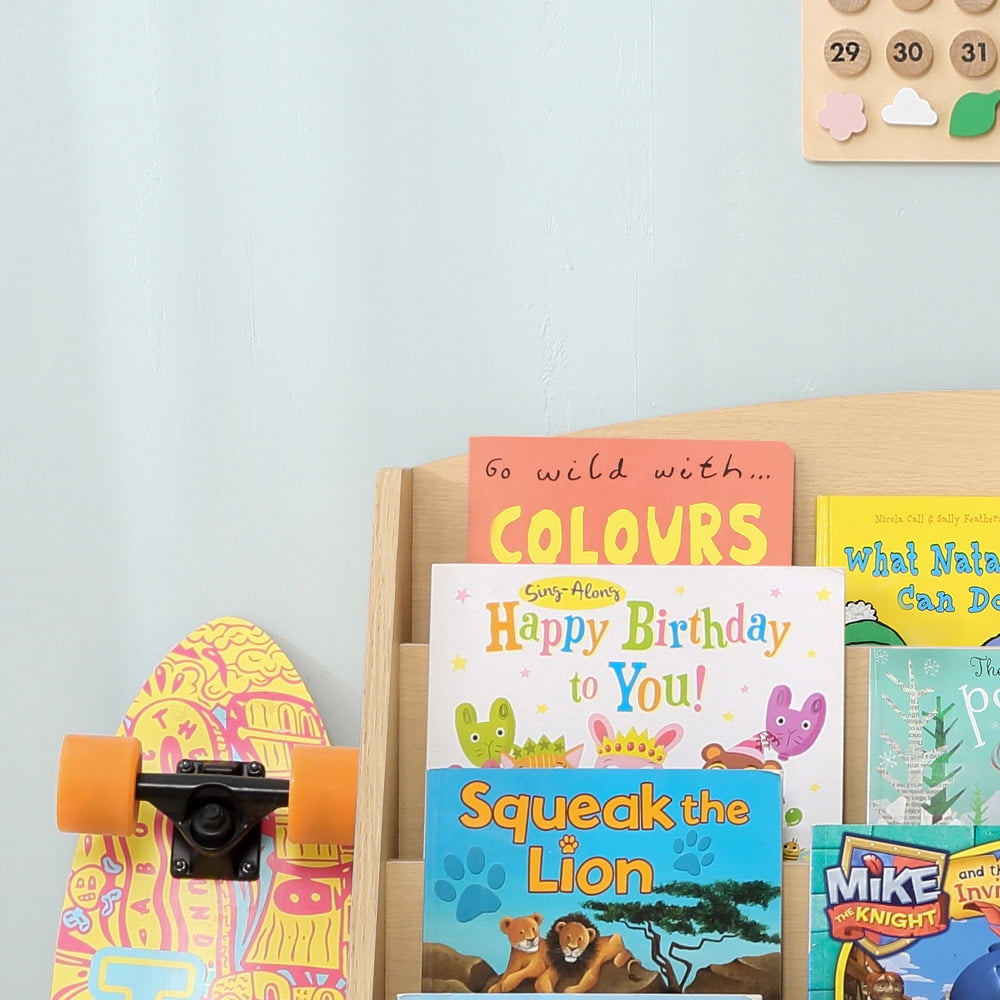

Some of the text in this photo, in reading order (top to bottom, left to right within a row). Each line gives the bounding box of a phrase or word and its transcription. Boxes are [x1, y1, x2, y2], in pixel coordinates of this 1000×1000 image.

[830, 41, 860, 63] 29
[893, 42, 923, 63] 30
[961, 42, 988, 63] 31
[485, 457, 511, 480] Go
[537, 452, 628, 481] wild
[490, 501, 768, 565] COLOURS
[875, 514, 904, 524] Nicola
[907, 514, 925, 524] Call
[936, 514, 960, 527] Sally
[844, 540, 919, 577] What
[525, 580, 620, 603] Sing-Along
[897, 584, 955, 613] Can
[485, 600, 792, 659] Happy Birthday
[569, 661, 707, 713] to You!
[459, 780, 750, 844] Squeak the
[528, 835, 655, 895] Lion
[958, 865, 985, 880] and
[835, 905, 937, 929] THE KNIGHT
